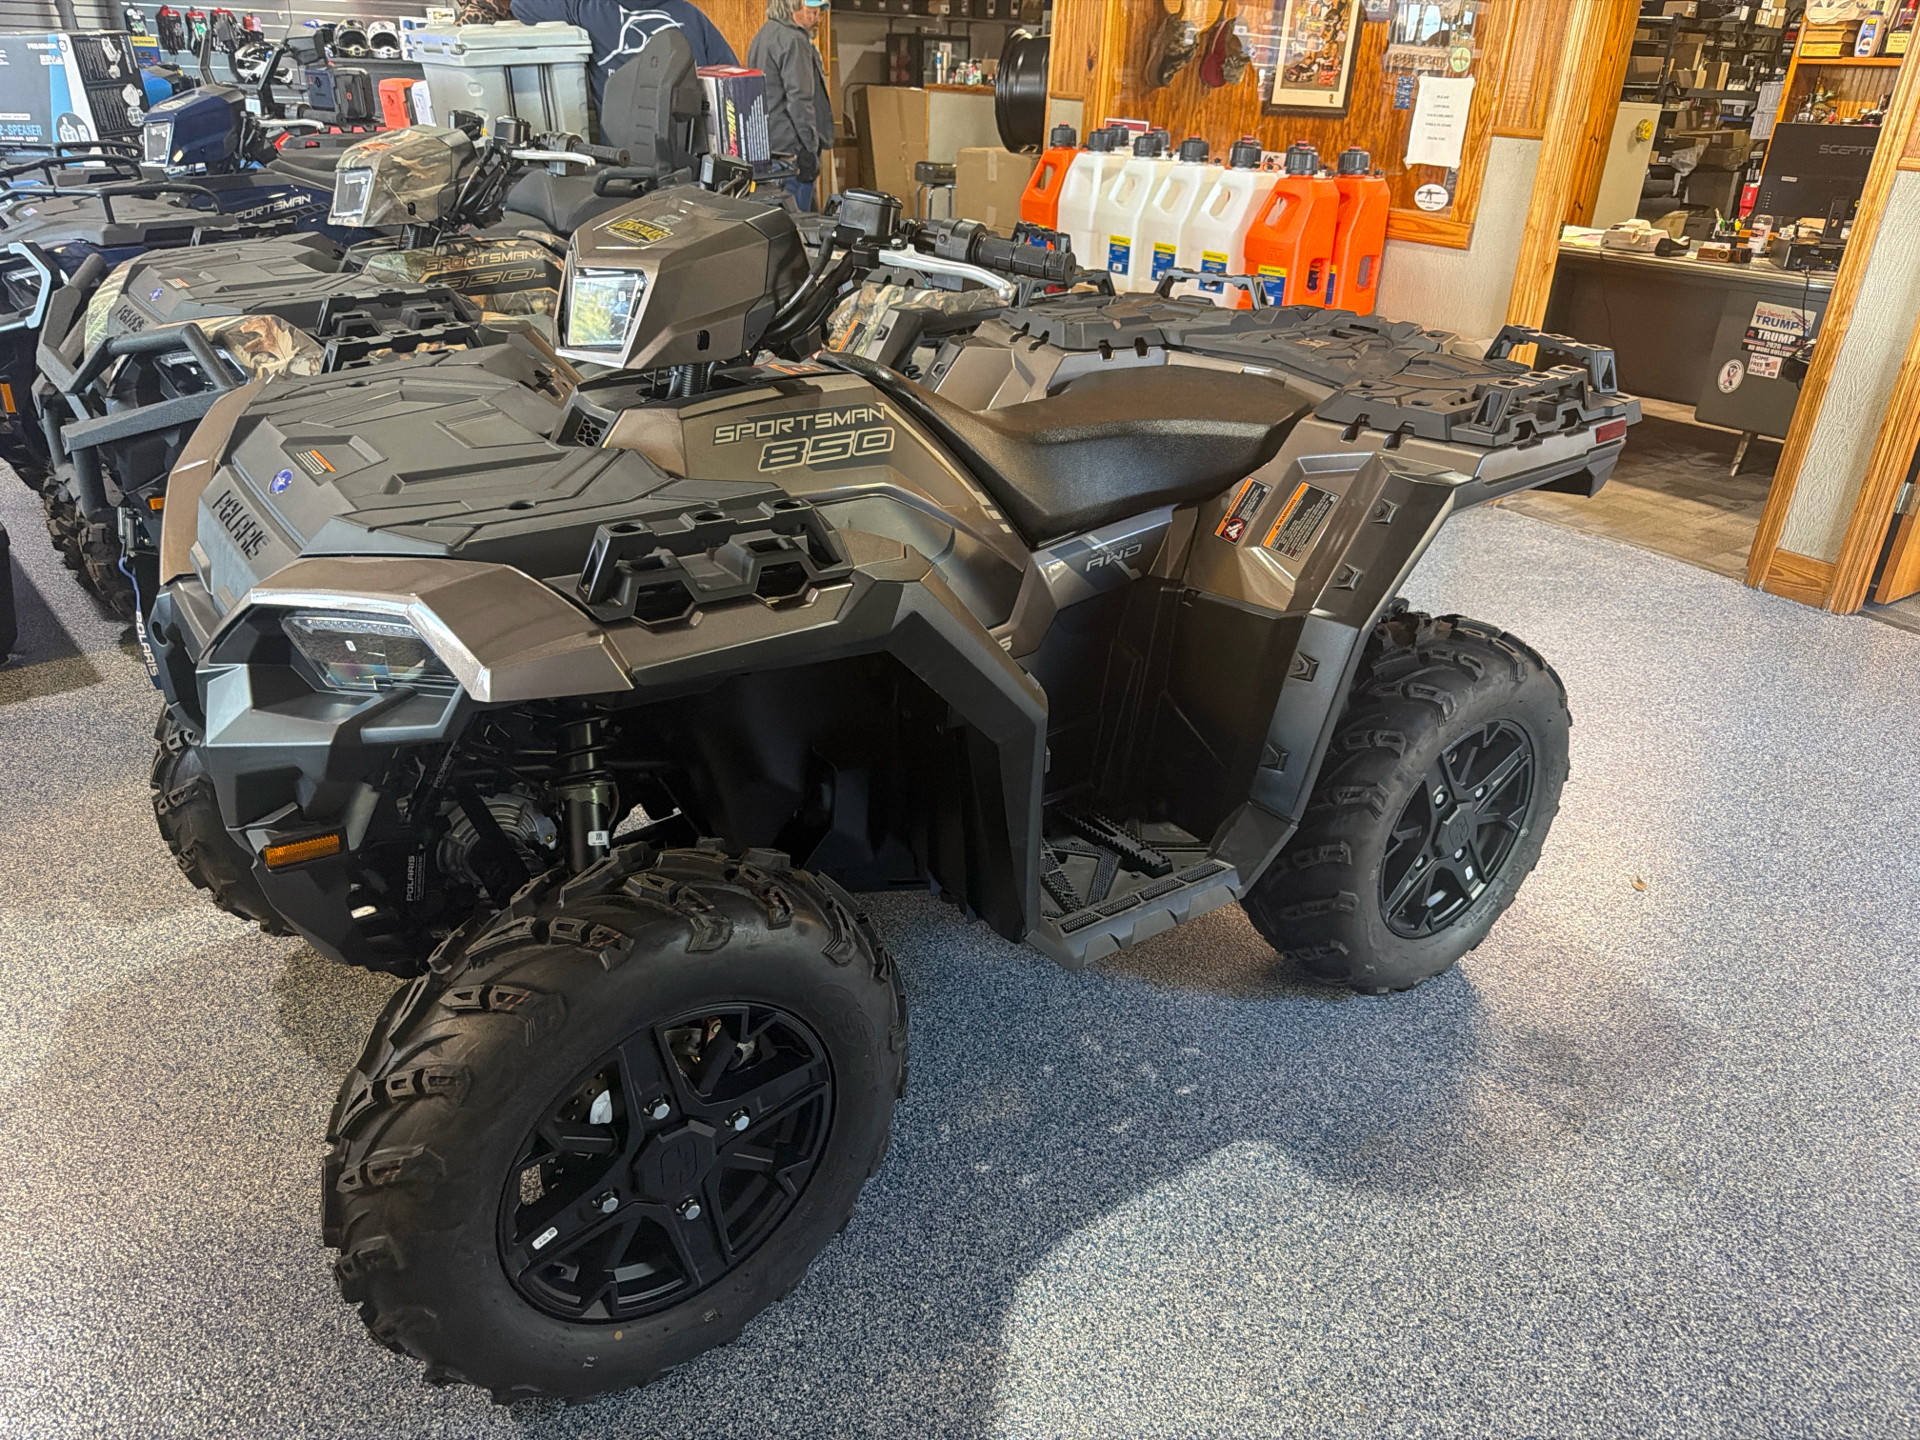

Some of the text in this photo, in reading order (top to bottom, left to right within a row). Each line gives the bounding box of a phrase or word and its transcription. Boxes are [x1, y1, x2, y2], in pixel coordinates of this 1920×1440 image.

[1818, 144, 1875, 156] SCEPTR
[234, 193, 312, 220] PORTSMAN
[425, 250, 538, 271] SPORTSMAN
[1755, 315, 1800, 330] TRUMP
[1755, 346, 1770, 354] MORE
[1757, 330, 1796, 345] TRUMP
[1765, 341, 1782, 350] 2020
[714, 405, 885, 444] SPORTSMAN
[757, 426, 896, 473] 850
[1225, 491, 1245, 519] WARNING
[1278, 498, 1298, 525] WARNING
[211, 489, 271, 561] POLARIS
[1085, 543, 1143, 572] AWD
[135, 610, 160, 677] POLARIS
[433, 754, 453, 789] POLARIS
[406, 855, 416, 902] POLARIS
